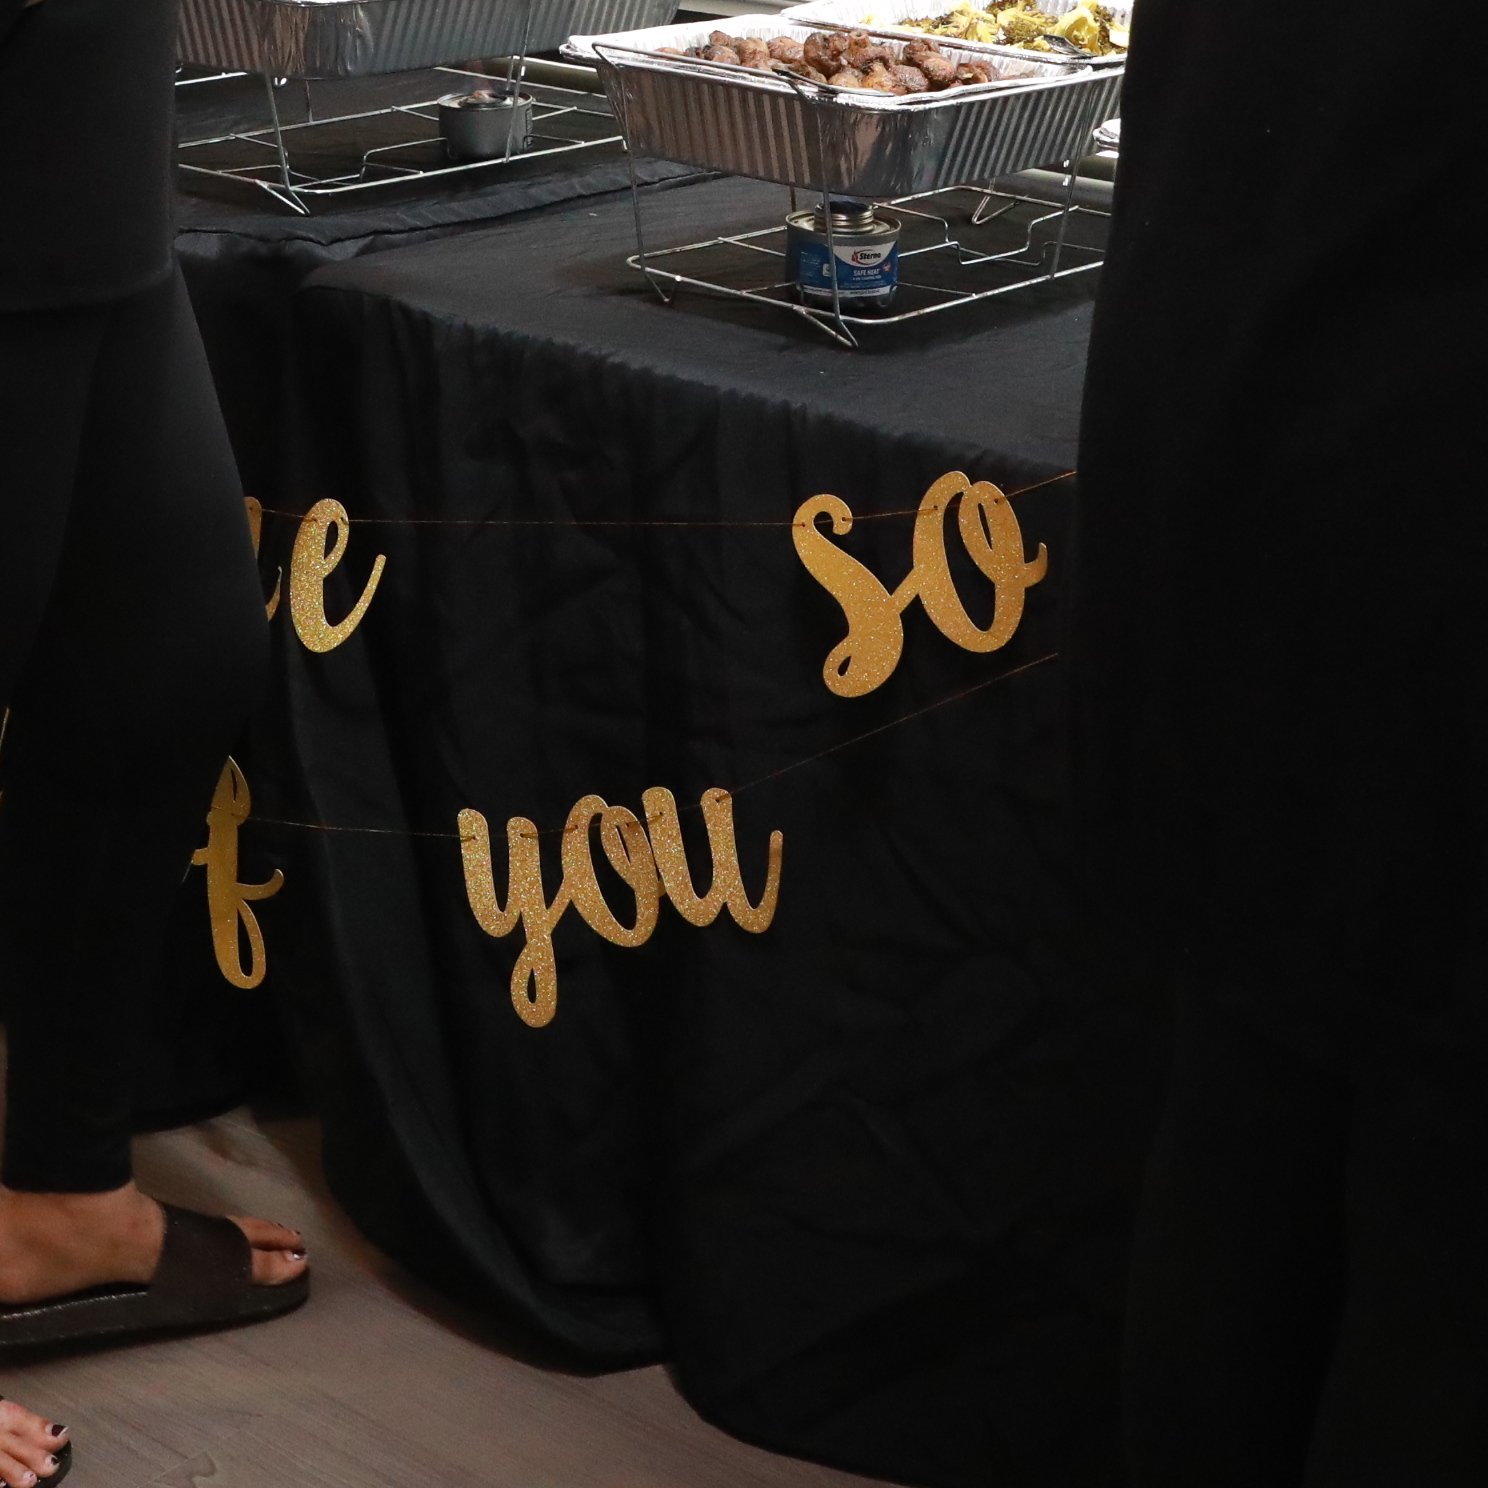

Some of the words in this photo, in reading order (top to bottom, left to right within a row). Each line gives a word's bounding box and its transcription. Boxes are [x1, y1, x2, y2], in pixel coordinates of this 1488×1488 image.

[859, 252, 881, 260] Sterno
[792, 470, 1047, 697] so
[457, 786, 783, 1027] you
